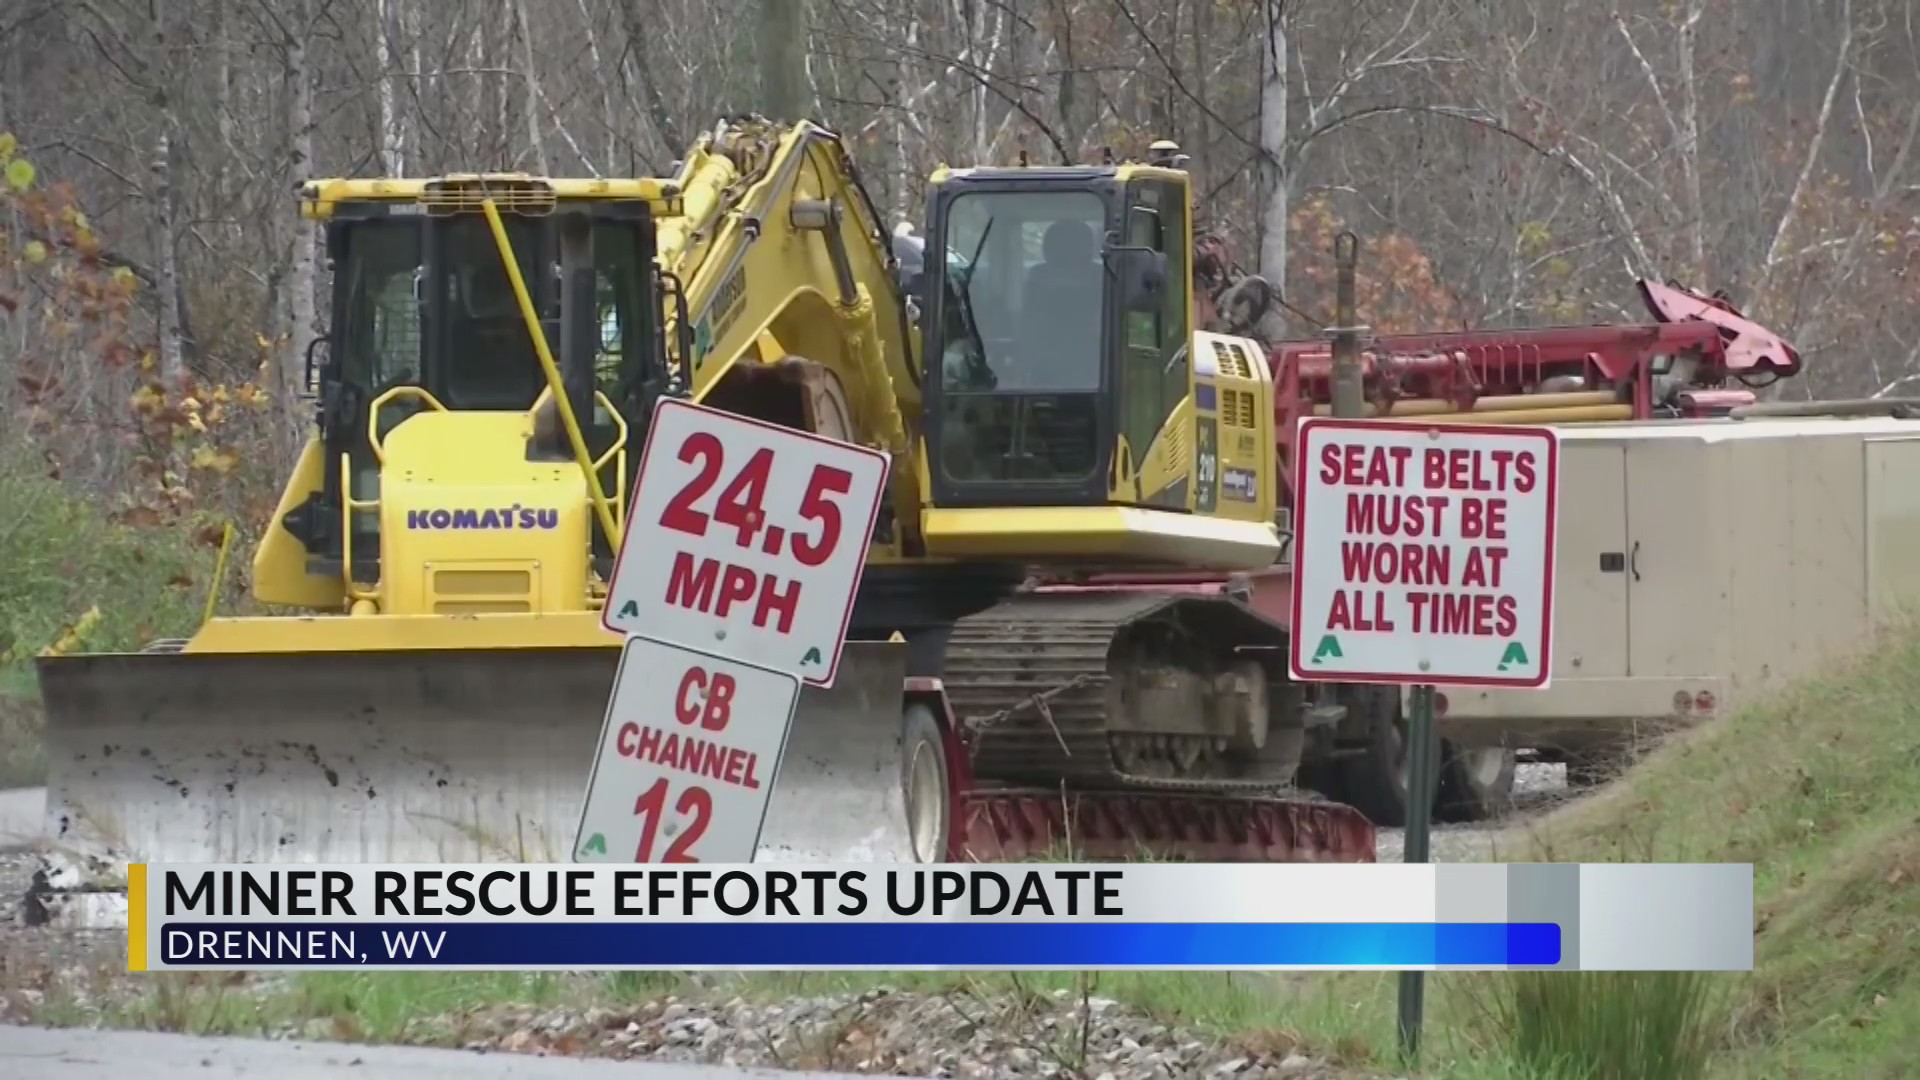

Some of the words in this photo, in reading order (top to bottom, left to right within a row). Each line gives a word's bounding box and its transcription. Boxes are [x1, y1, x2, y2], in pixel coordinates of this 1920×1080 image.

[1319, 442, 1413, 488] SEAT
[1424, 447, 1536, 493] BELTS
[407, 503, 559, 530] KOMATSU
[658, 431, 853, 567] 24.5
[1345, 493, 1449, 537] MUST
[1461, 498, 1507, 539] BE
[664, 550, 802, 635] MPH
[1341, 541, 1450, 586] WORN
[1461, 546, 1508, 587] AT
[1326, 589, 1395, 632] ALL
[1406, 592, 1517, 637] TIMES
[675, 666, 736, 732] CB
[616, 720, 760, 790] CHANNEL
[633, 776, 713, 864] 12
